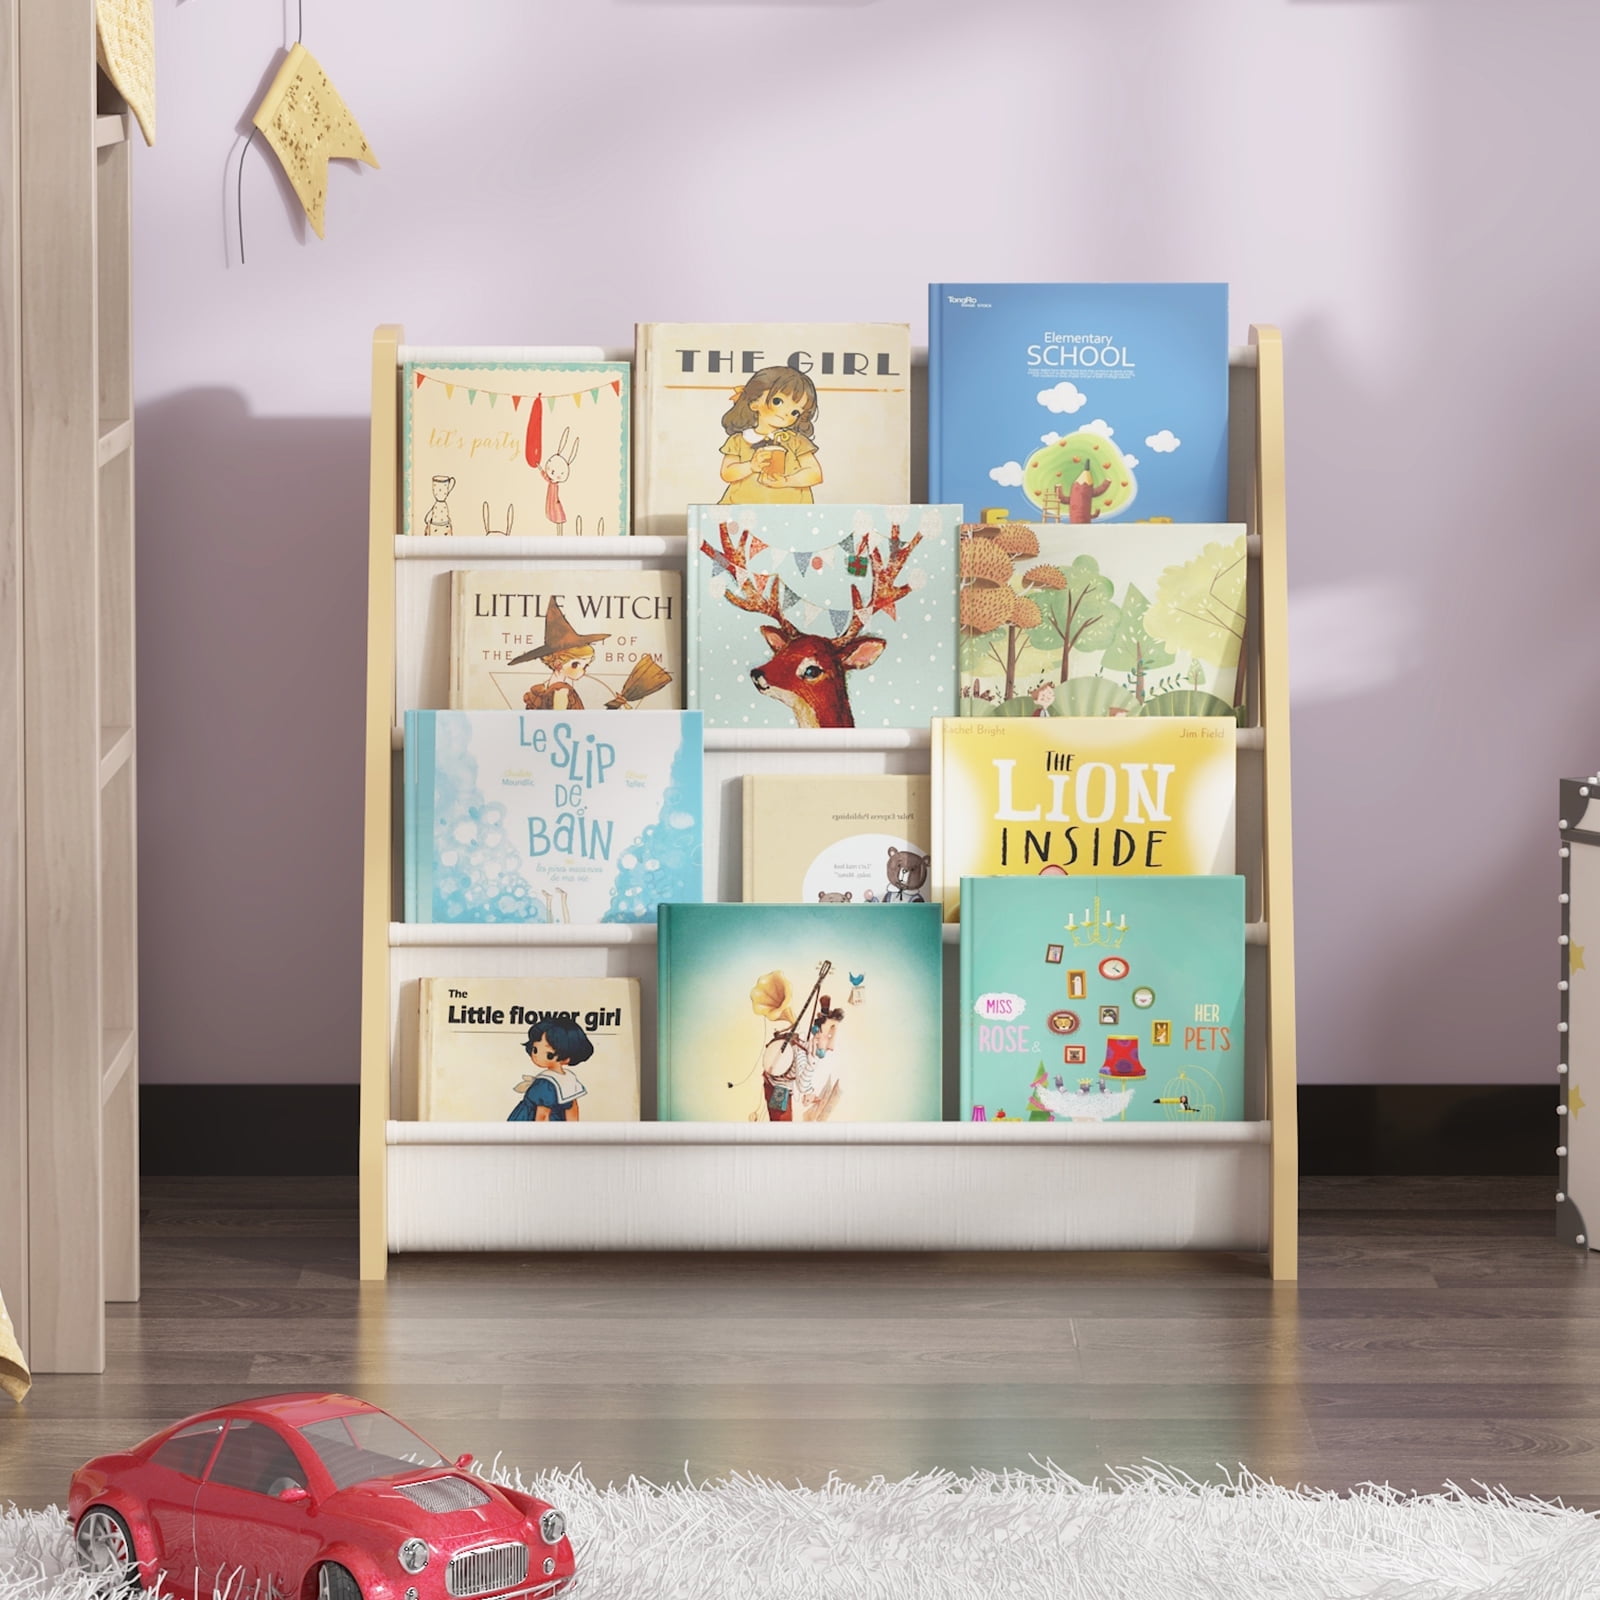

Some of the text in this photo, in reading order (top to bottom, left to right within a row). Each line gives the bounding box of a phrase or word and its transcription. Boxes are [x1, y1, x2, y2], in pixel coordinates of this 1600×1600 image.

[1044, 331, 1113, 346] Elementary
[676, 350, 900, 376] THE GIRL
[1026, 344, 1136, 367] SCHOOL
[469, 431, 520, 461] party
[577, 595, 673, 620] WITCH
[502, 632, 533, 645] THE
[617, 636, 638, 646] OF
[483, 650, 513, 661] THE
[519, 715, 547, 753] Le
[976, 723, 1006, 737] Bright
[1179, 727, 1225, 738] Jim Field
[1045, 750, 1076, 771] THE
[992, 758, 1176, 824] LION
[1001, 826, 1167, 867] INSIDE
[448, 989, 468, 998] The
[448, 1005, 621, 1031] Little flower girl
[986, 999, 1013, 1014] MISS
[1194, 1003, 1220, 1022] HER
[978, 1024, 1031, 1053] ROSE
[1184, 1026, 1231, 1051] PETS
